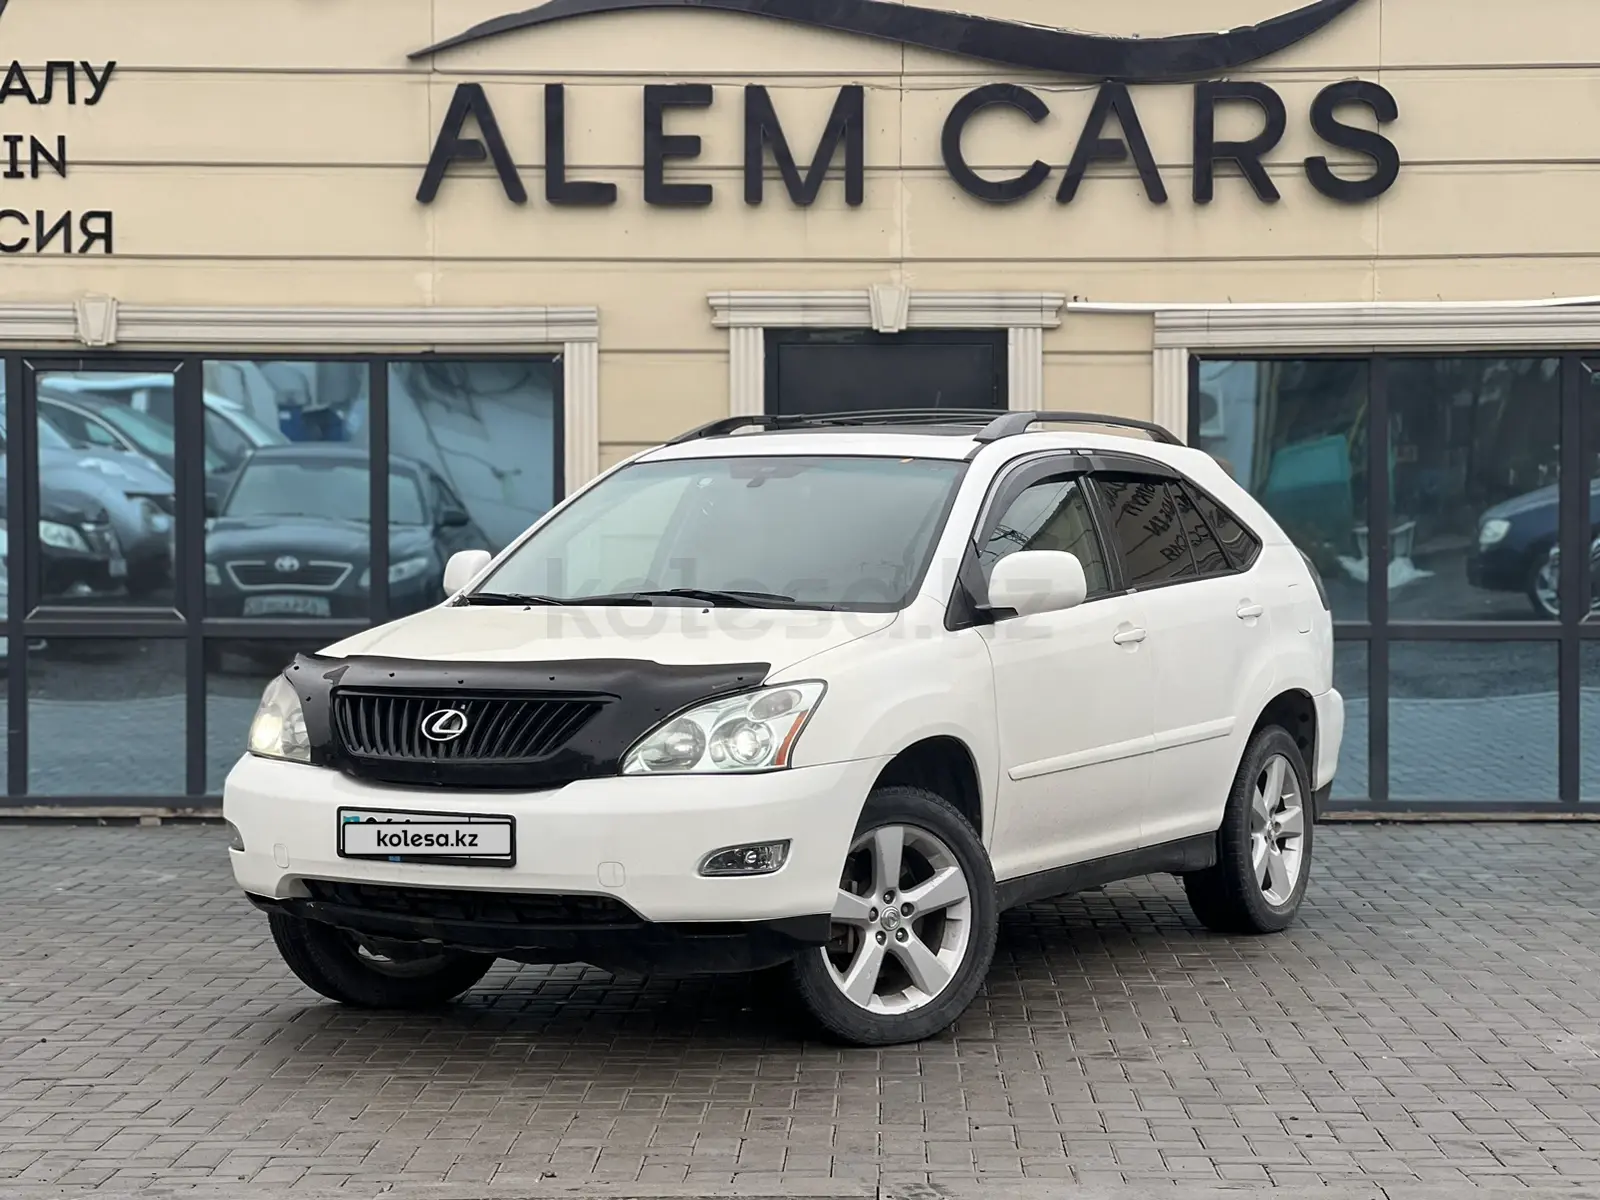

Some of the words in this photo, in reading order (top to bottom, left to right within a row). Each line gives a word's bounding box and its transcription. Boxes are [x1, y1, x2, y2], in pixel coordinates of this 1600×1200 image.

[0, 60, 116, 105] АЛУ
[3, 134, 66, 178] IN
[415, 82, 865, 206] ALEM
[941, 79, 1400, 204] CARS
[0, 209, 113, 254] СИЯ
